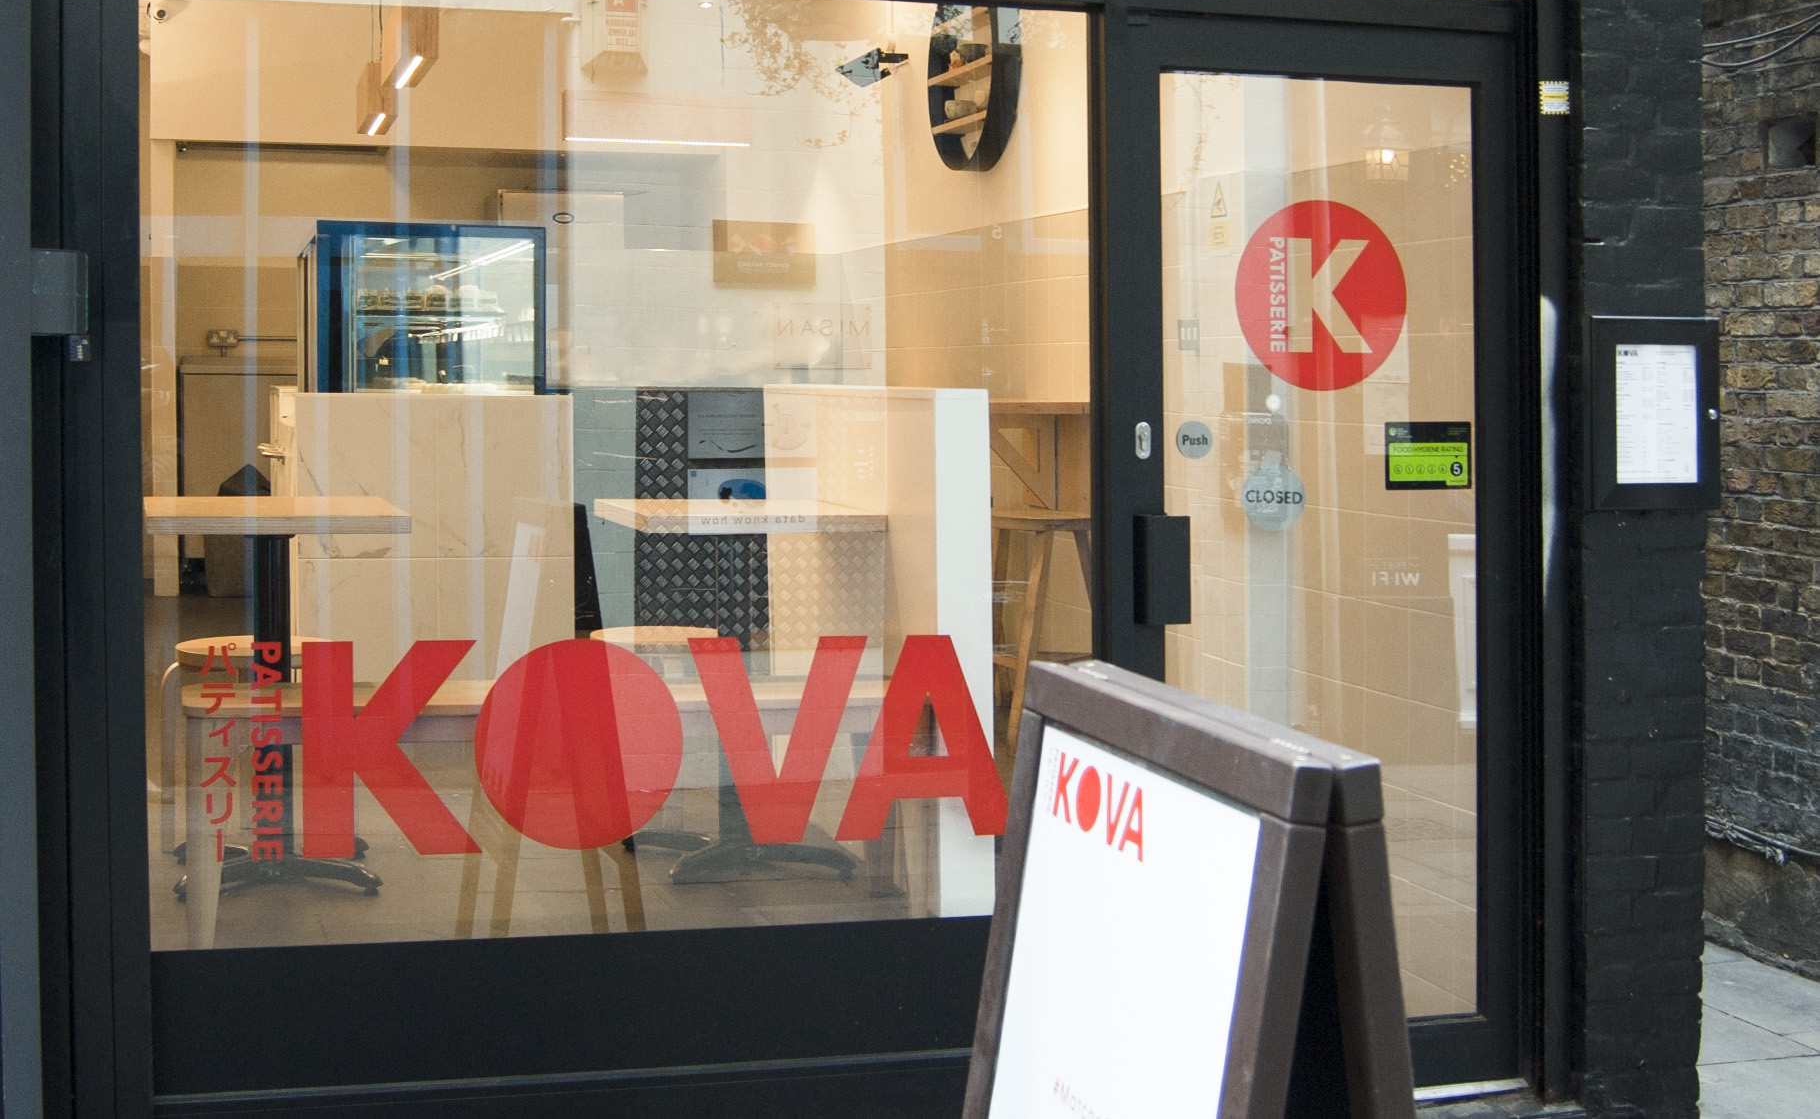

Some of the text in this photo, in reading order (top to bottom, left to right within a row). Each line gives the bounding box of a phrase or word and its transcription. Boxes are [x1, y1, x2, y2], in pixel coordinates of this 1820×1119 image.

[1269, 236, 1287, 353] PATISSERIE
[1286, 237, 1374, 354] K
[1182, 434, 1209, 447] Push
[1245, 489, 1303, 505] CLOSED
[1413, 445, 1439, 453] HYGIENE
[1441, 445, 1464, 453] RATING
[1453, 463, 1461, 475] 5
[200, 642, 237, 863] パティスリー
[250, 641, 284, 863] PATISSERIE
[301, 634, 1010, 859] KOVA
[1052, 751, 1144, 863] KOVA
